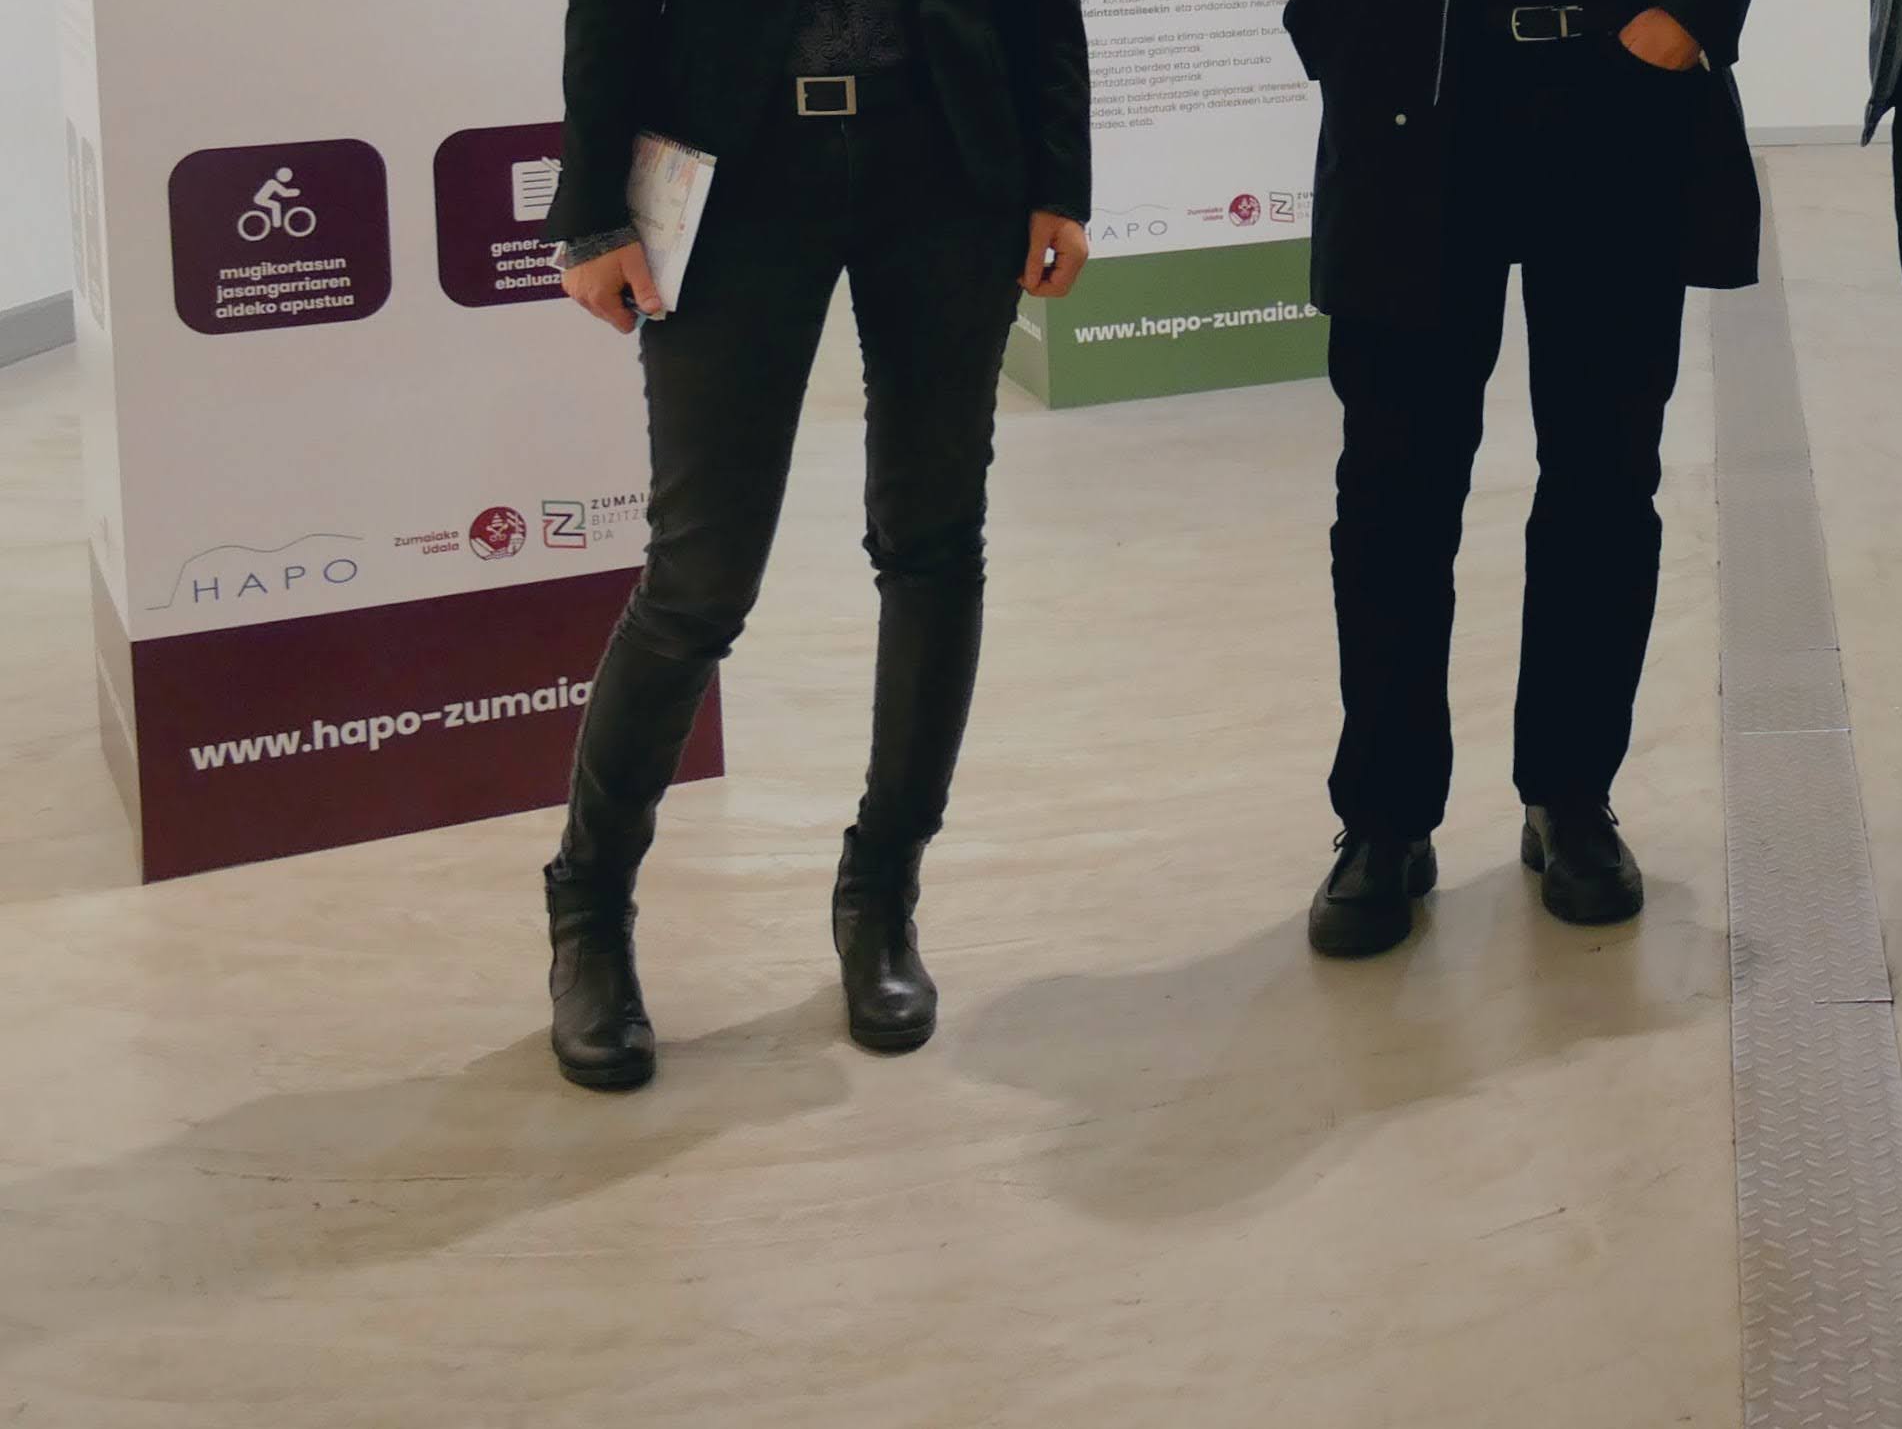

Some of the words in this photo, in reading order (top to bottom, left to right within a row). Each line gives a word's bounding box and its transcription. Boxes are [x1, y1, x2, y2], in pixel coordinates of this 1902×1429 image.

[219, 258, 346, 281] mugikortasun
[215, 301, 277, 318] aldeko
[279, 295, 354, 315] apustua
[217, 275, 354, 307] jasangarriaren
[1074, 301, 1318, 343] www.hapo-zumaia.e
[193, 559, 358, 603] HAPO
[189, 677, 595, 770] www.hapo-zumaia
